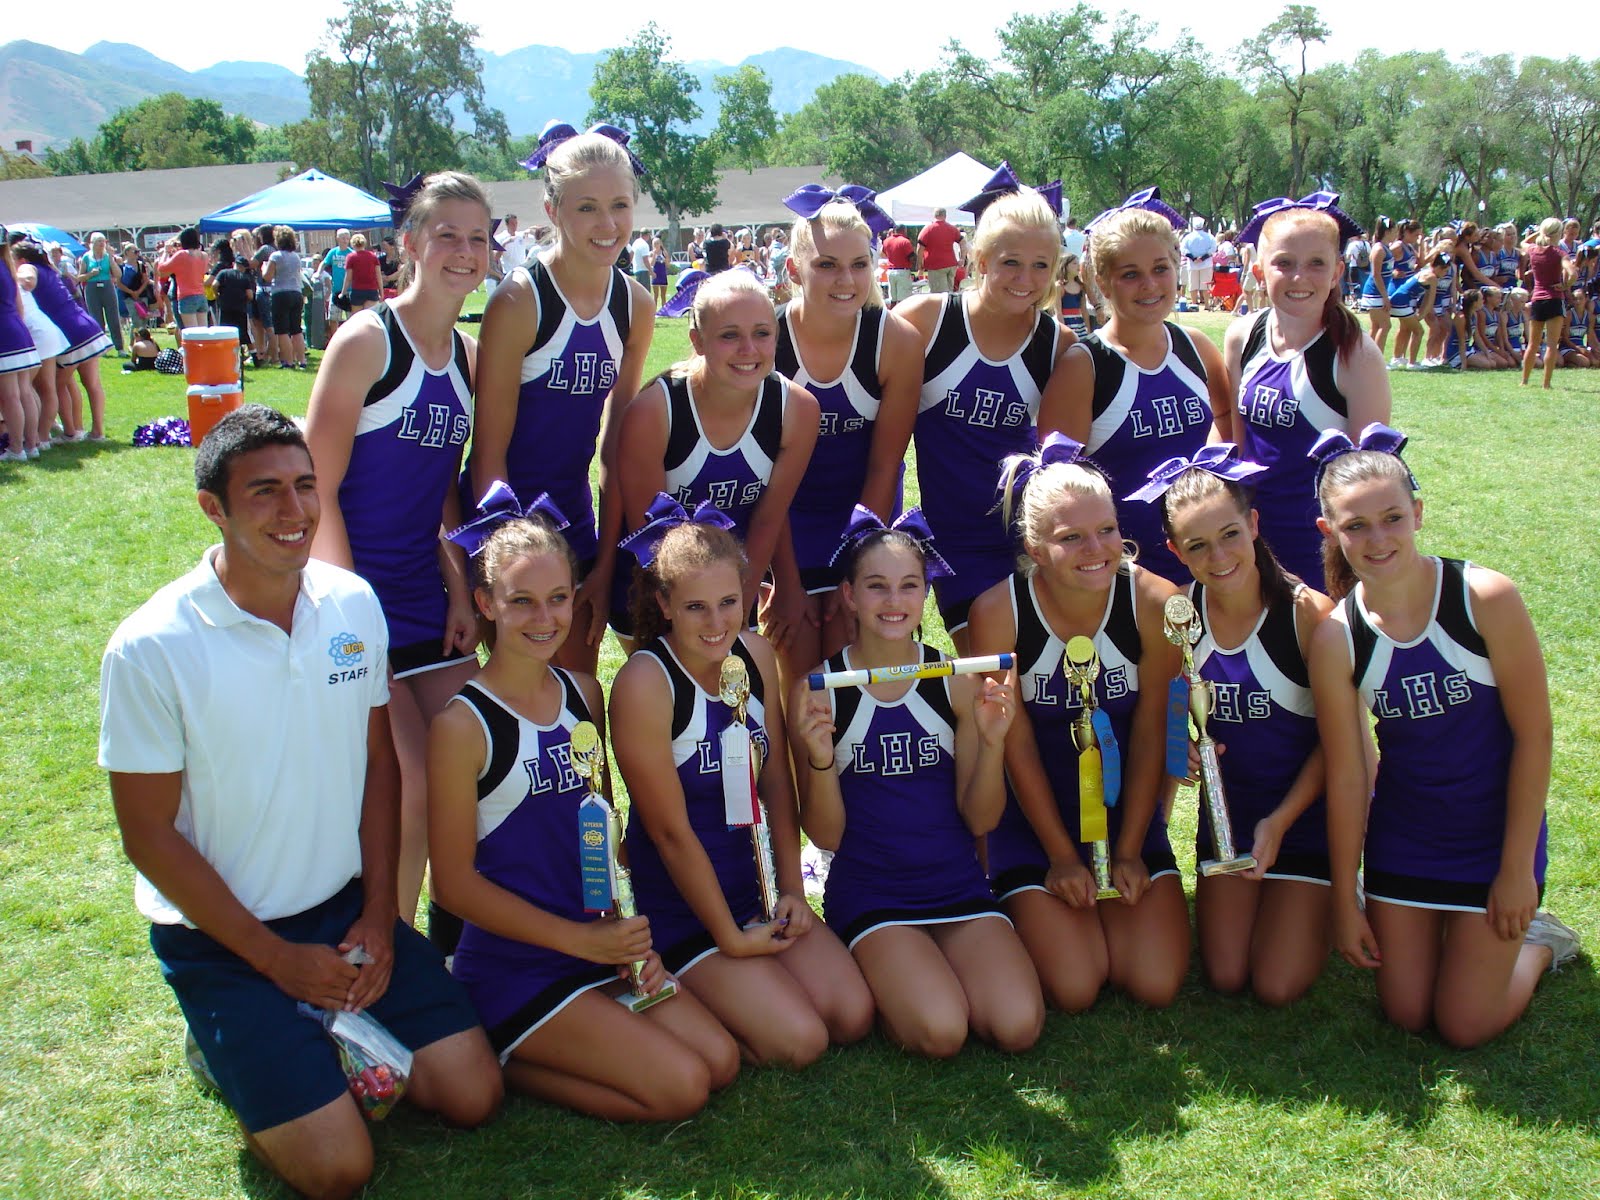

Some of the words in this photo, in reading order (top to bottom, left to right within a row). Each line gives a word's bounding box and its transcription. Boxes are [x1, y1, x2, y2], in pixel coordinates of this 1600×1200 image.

[546, 352, 616, 395] LHS
[398, 403, 470, 448] LHS
[819, 412, 865, 436] HS
[945, 388, 1028, 428] LHS
[1129, 395, 1205, 438] LHS
[677, 479, 762, 510] LHS
[343, 641, 365, 655] UCA
[889, 665, 920, 675] UCA
[923, 662, 949, 671] SPIRIT
[328, 667, 368, 685] STAFF
[1375, 671, 1473, 719] LHS
[1212, 682, 1271, 723] HS
[525, 741, 586, 796] LH
[698, 727, 768, 774] LS
[853, 731, 941, 776] LHS
